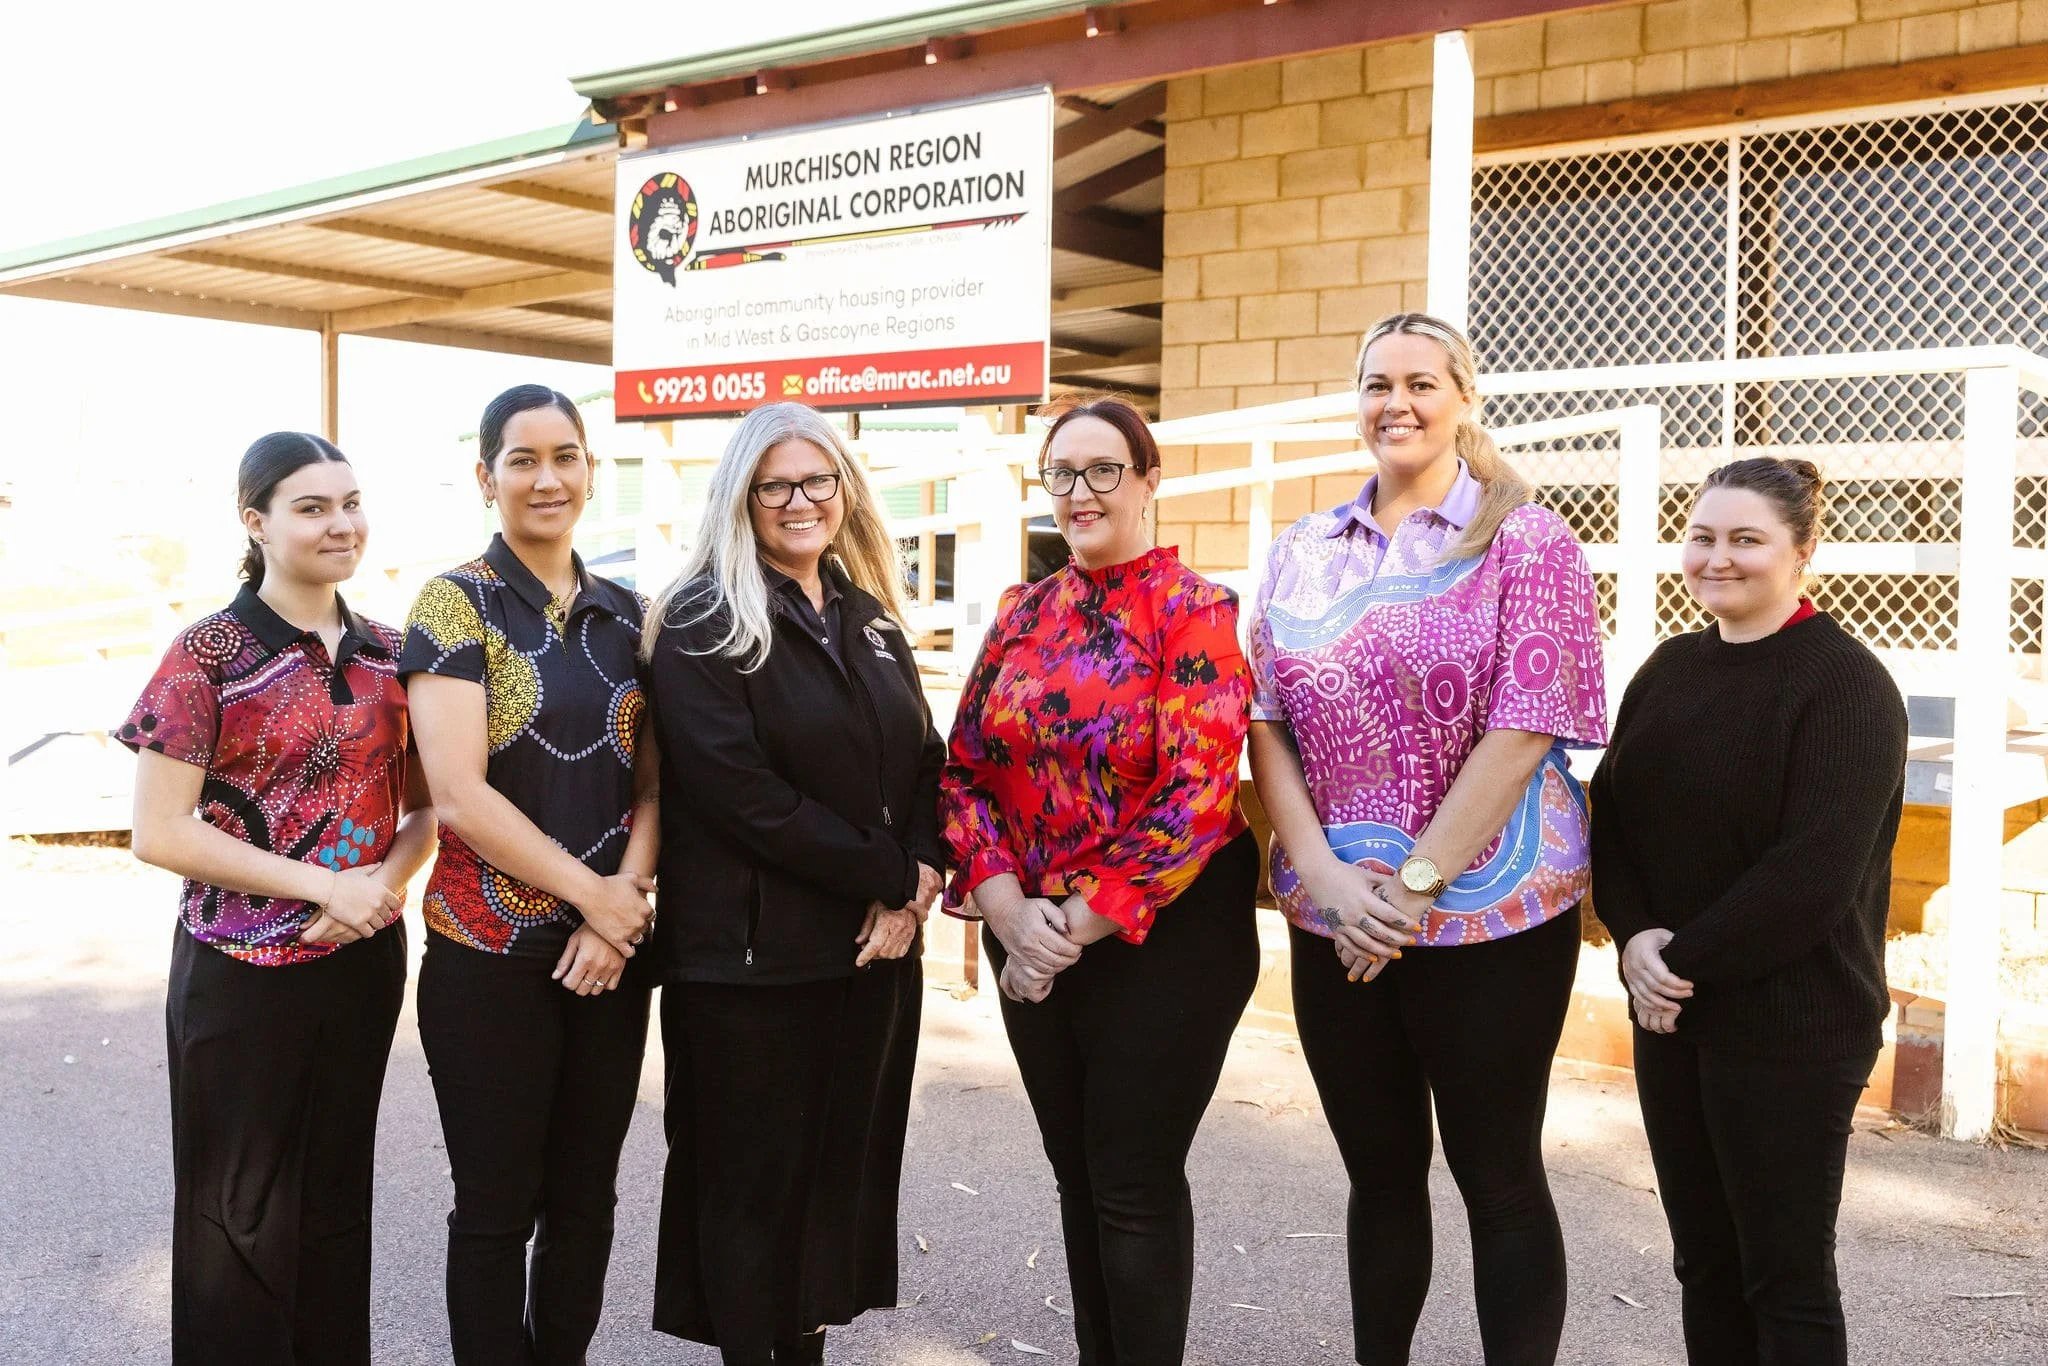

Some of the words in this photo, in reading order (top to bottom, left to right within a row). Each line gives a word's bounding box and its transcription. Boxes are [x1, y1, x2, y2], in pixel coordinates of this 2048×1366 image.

[745, 147, 880, 192] MURCHISON
[890, 131, 982, 172] REGION
[709, 195, 842, 237] ABORIGINAL
[850, 170, 1025, 217] CORPORATION
[664, 300, 741, 326] Aboriginal
[745, 293, 834, 316] community
[839, 286, 906, 309] housing
[911, 277, 985, 305] provider
[686, 336, 701, 351] in
[704, 331, 731, 349] Mid
[736, 327, 775, 347] West
[780, 325, 792, 343] &
[797, 320, 881, 343] Gascoyne
[885, 313, 955, 339] Regions
[653, 374, 707, 404] 9923
[712, 372, 766, 401] 0055
[805, 362, 1011, 395] office@mrac.net.au
